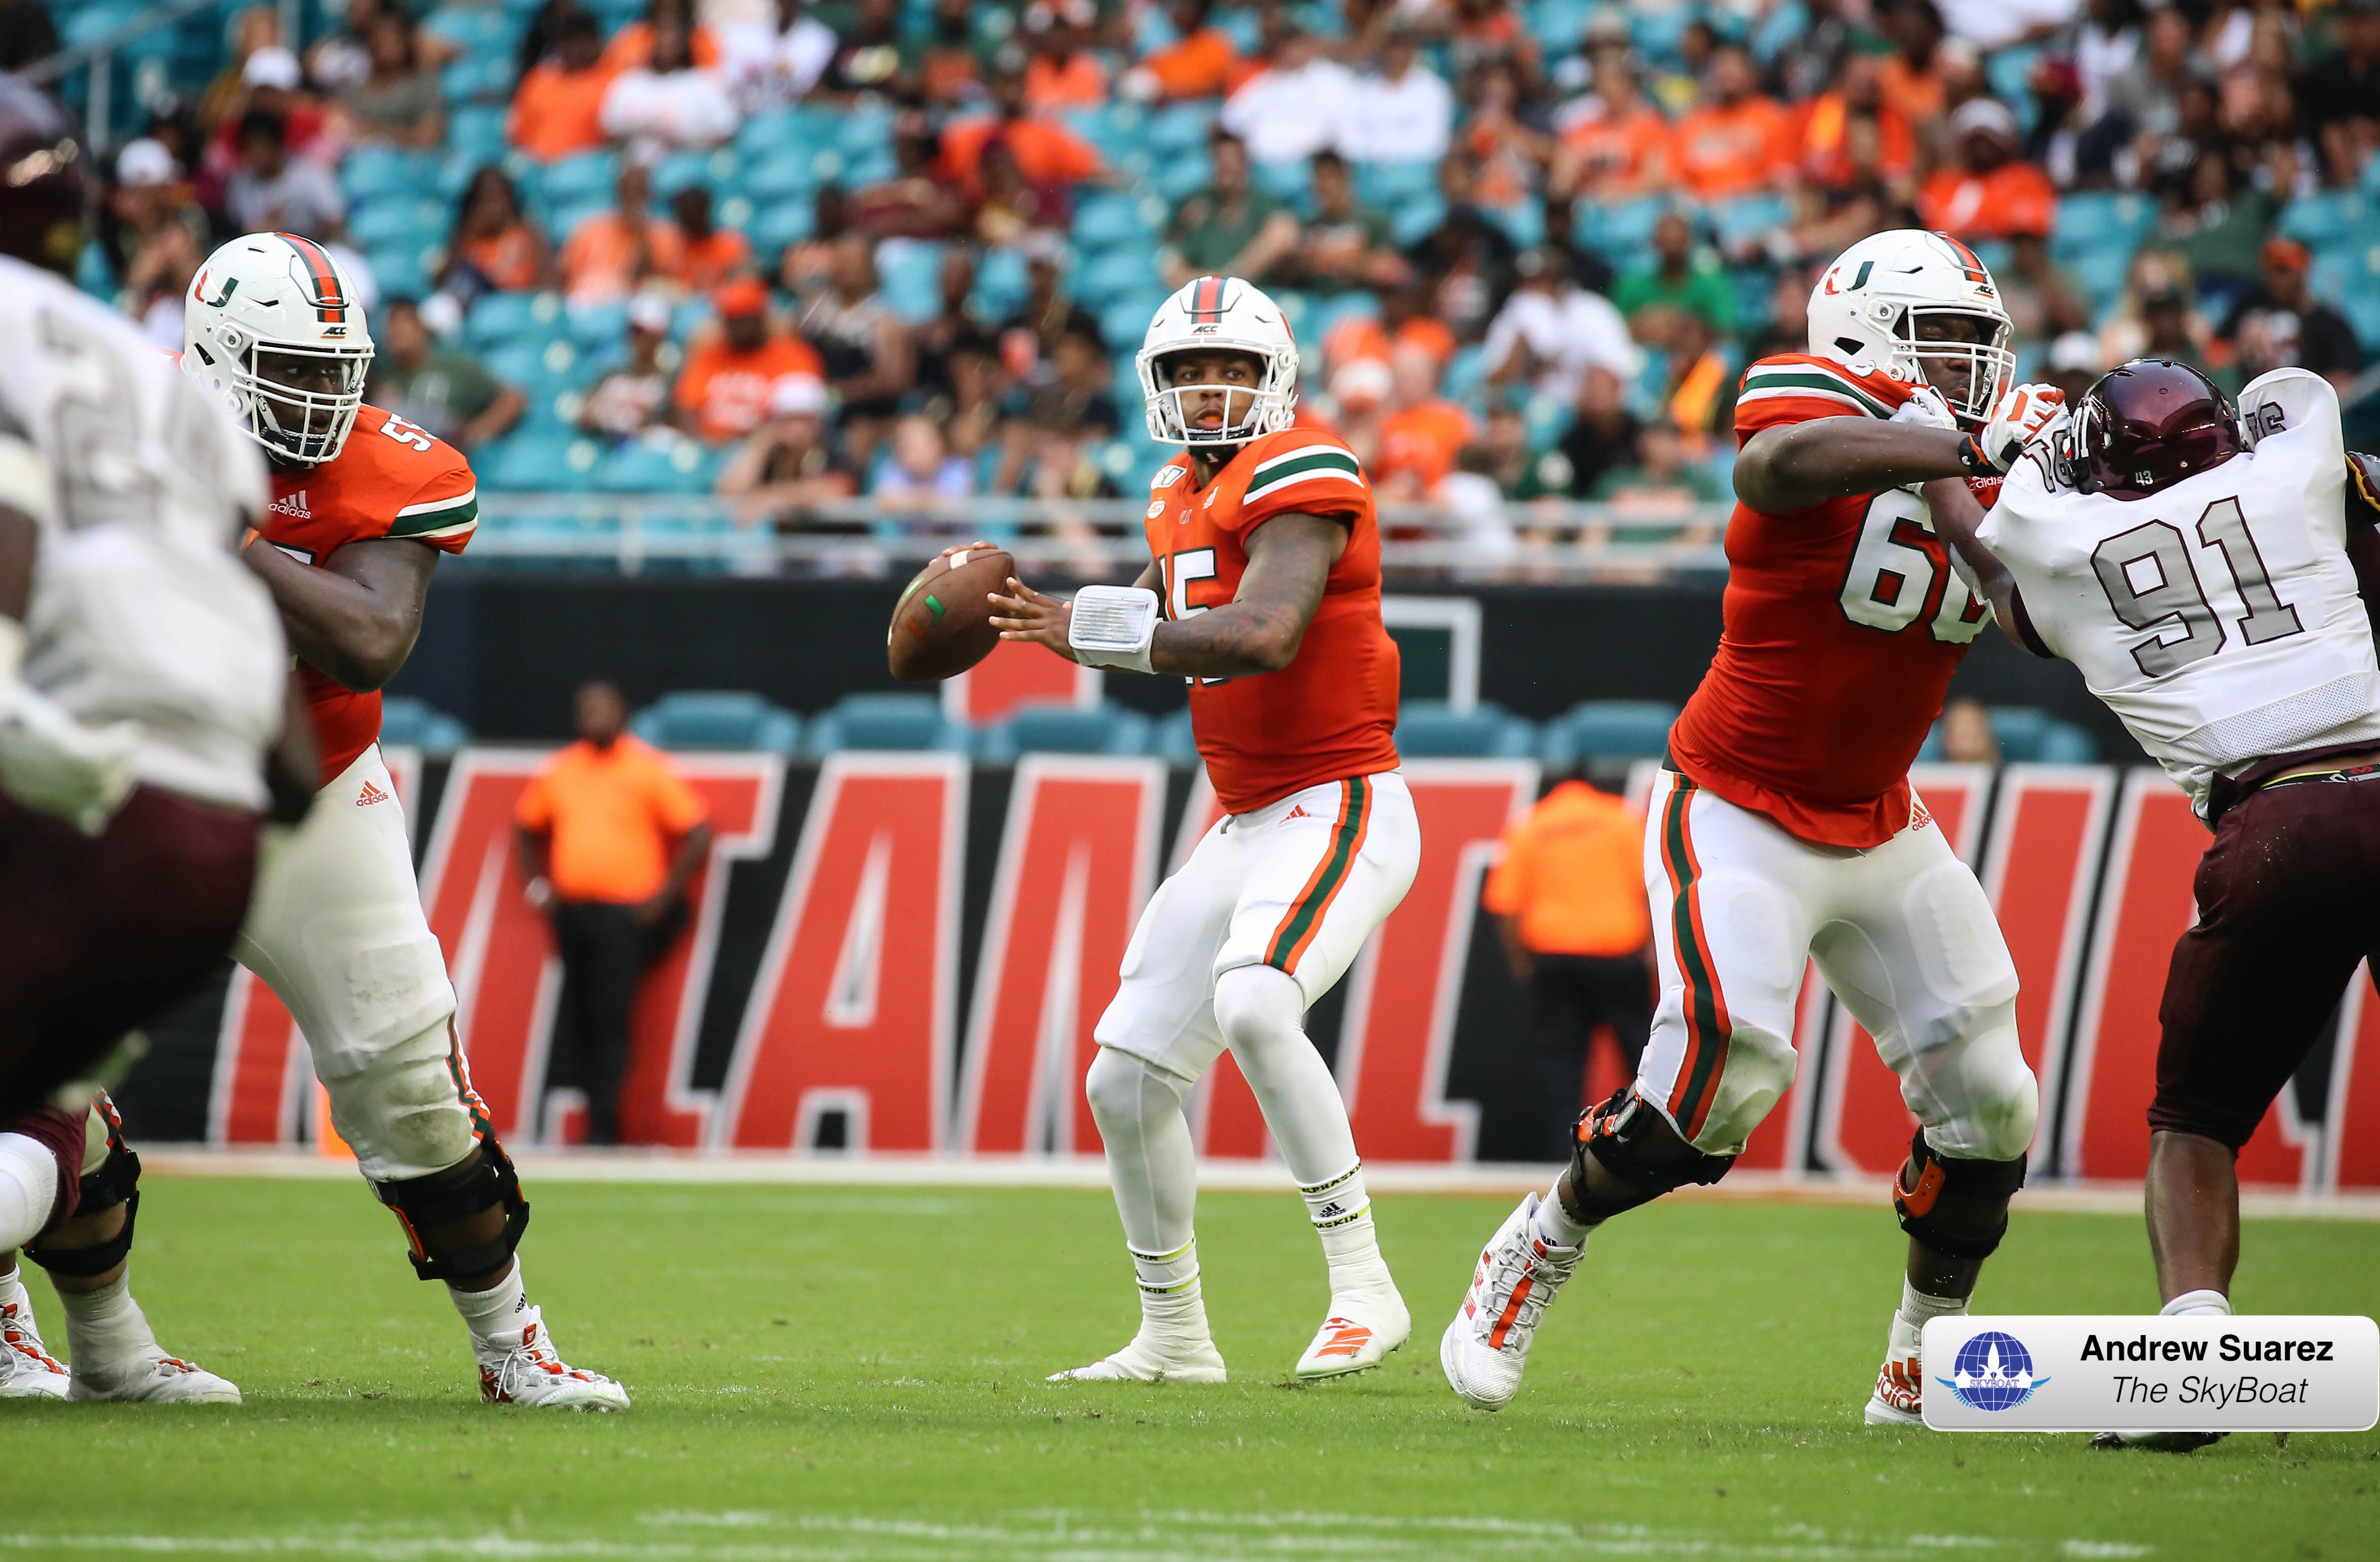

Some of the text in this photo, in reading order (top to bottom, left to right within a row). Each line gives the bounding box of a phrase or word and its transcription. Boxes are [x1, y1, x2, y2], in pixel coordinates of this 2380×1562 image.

[323, 326, 348, 335] ACC
[1193, 325, 1219, 333] ACC
[2135, 470, 2154, 486] 43
[268, 502, 312, 519] adidas
[2090, 495, 2306, 678] 91
[356, 792, 389, 806] adidas
